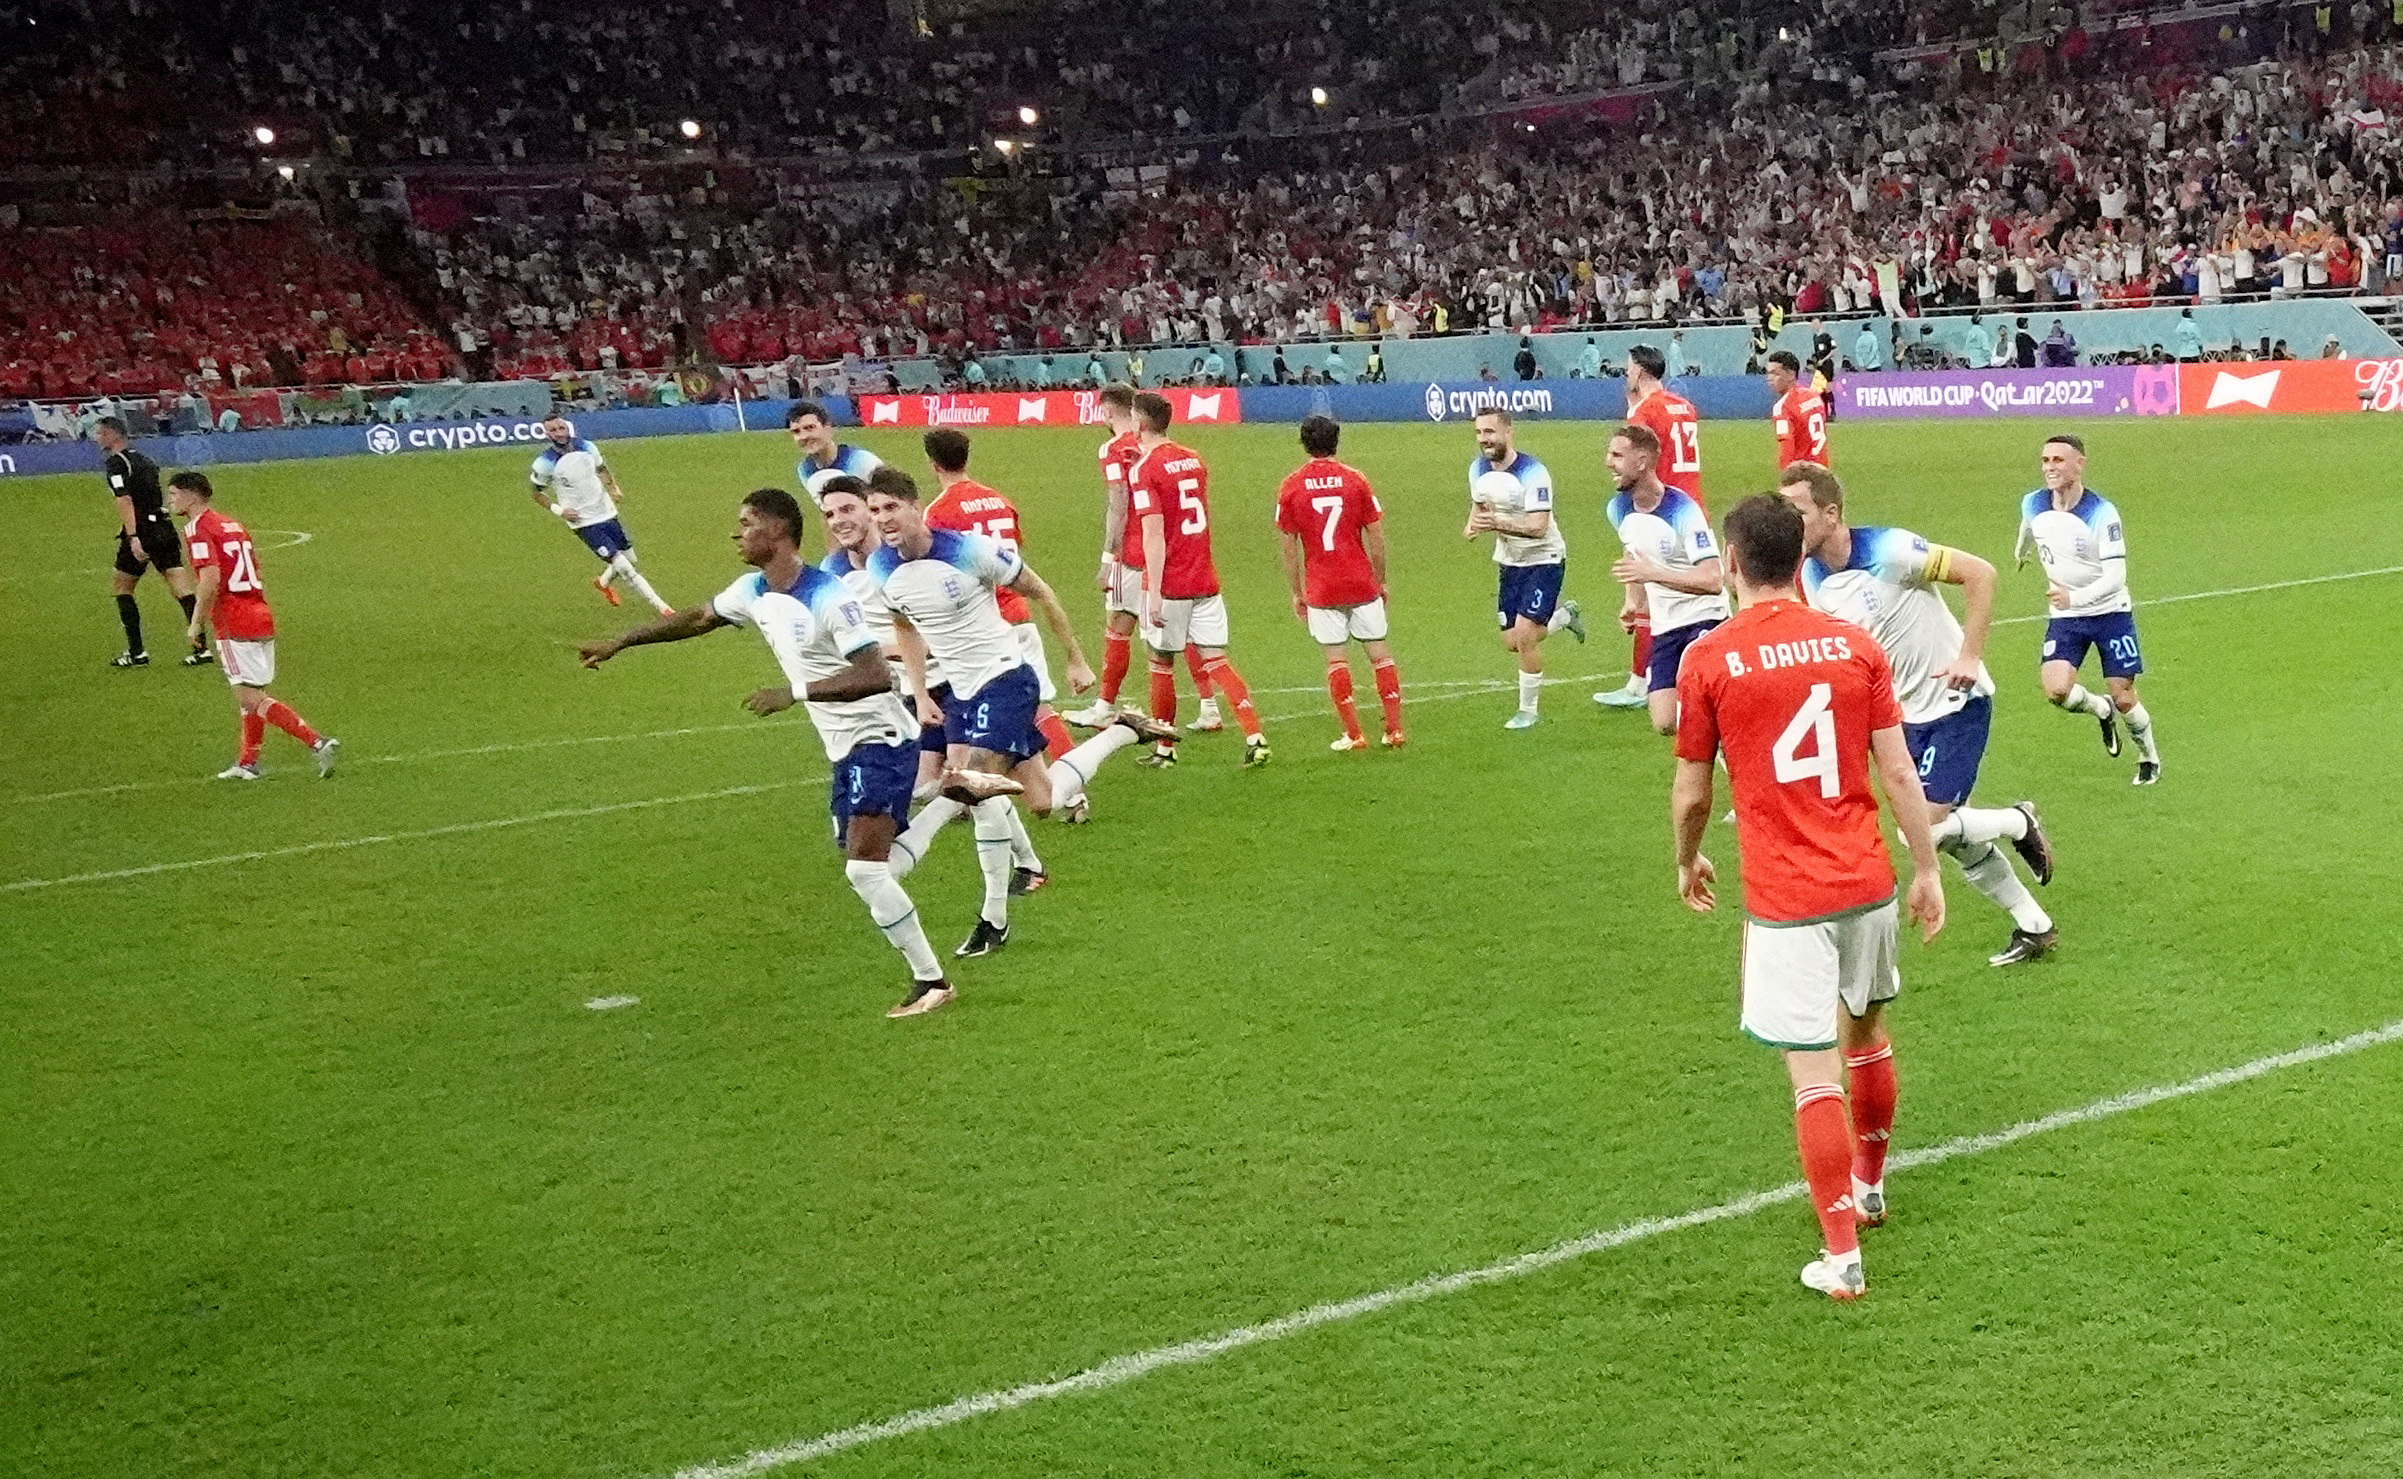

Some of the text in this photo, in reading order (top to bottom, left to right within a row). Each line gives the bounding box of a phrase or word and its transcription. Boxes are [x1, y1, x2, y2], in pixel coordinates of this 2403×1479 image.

[922, 394, 990, 426] Budweiser
[1450, 386, 1552, 417] crypto.com
[1856, 387, 1887, 406] FIFA
[1887, 386, 1943, 406] WORLD
[1670, 422, 1700, 473] 13
[1808, 413, 1827, 456] 9
[1178, 478, 1207, 535] 5
[1311, 496, 1344, 551] 7
[223, 540, 263, 592] 20
[1530, 589, 1543, 609] 3
[1725, 636, 1852, 677] B. DAVIES
[2110, 635, 2138, 660] 20
[1772, 683, 1841, 799] 4
[1919, 746, 1936, 776] 9
